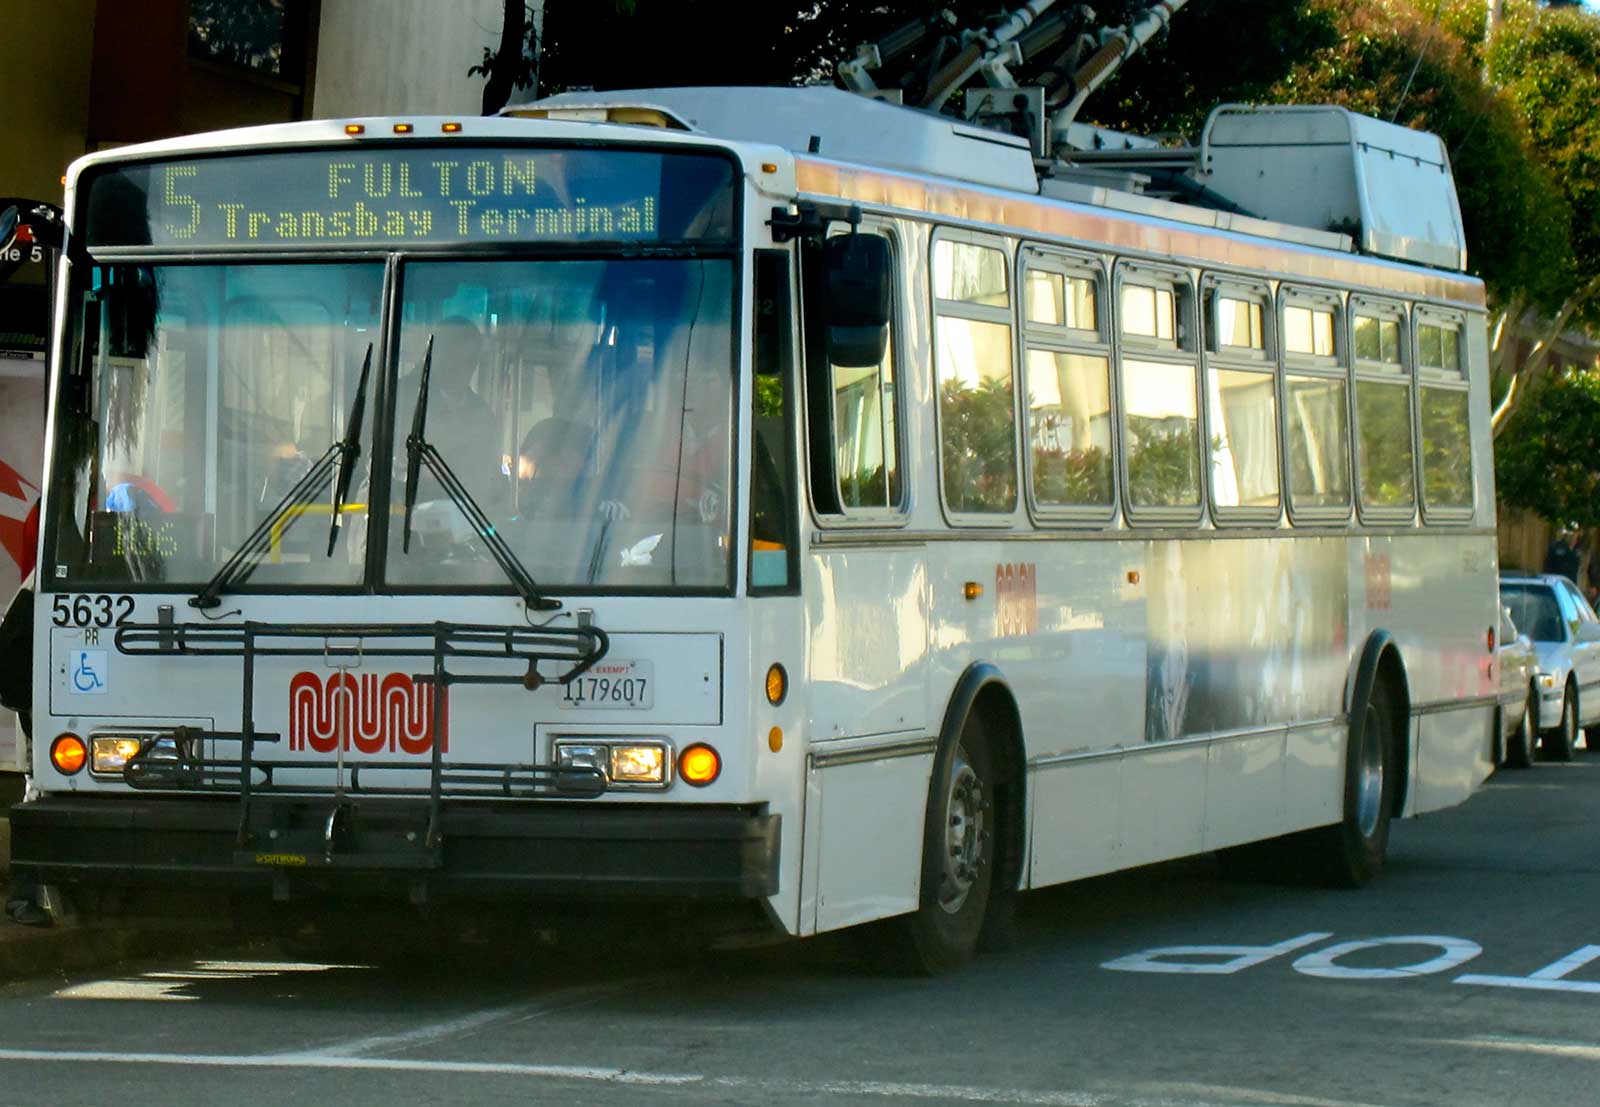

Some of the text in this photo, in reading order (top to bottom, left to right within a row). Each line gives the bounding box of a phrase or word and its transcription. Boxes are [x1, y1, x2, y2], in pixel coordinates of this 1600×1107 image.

[328, 159, 535, 198] FULTON
[165, 166, 200, 238] 5
[218, 197, 654, 236] Transbay Terminal
[30, 245, 43, 263] 5
[52, 594, 136, 628] 5632
[84, 629, 100, 646] PR
[563, 678, 647, 702] 1179607
